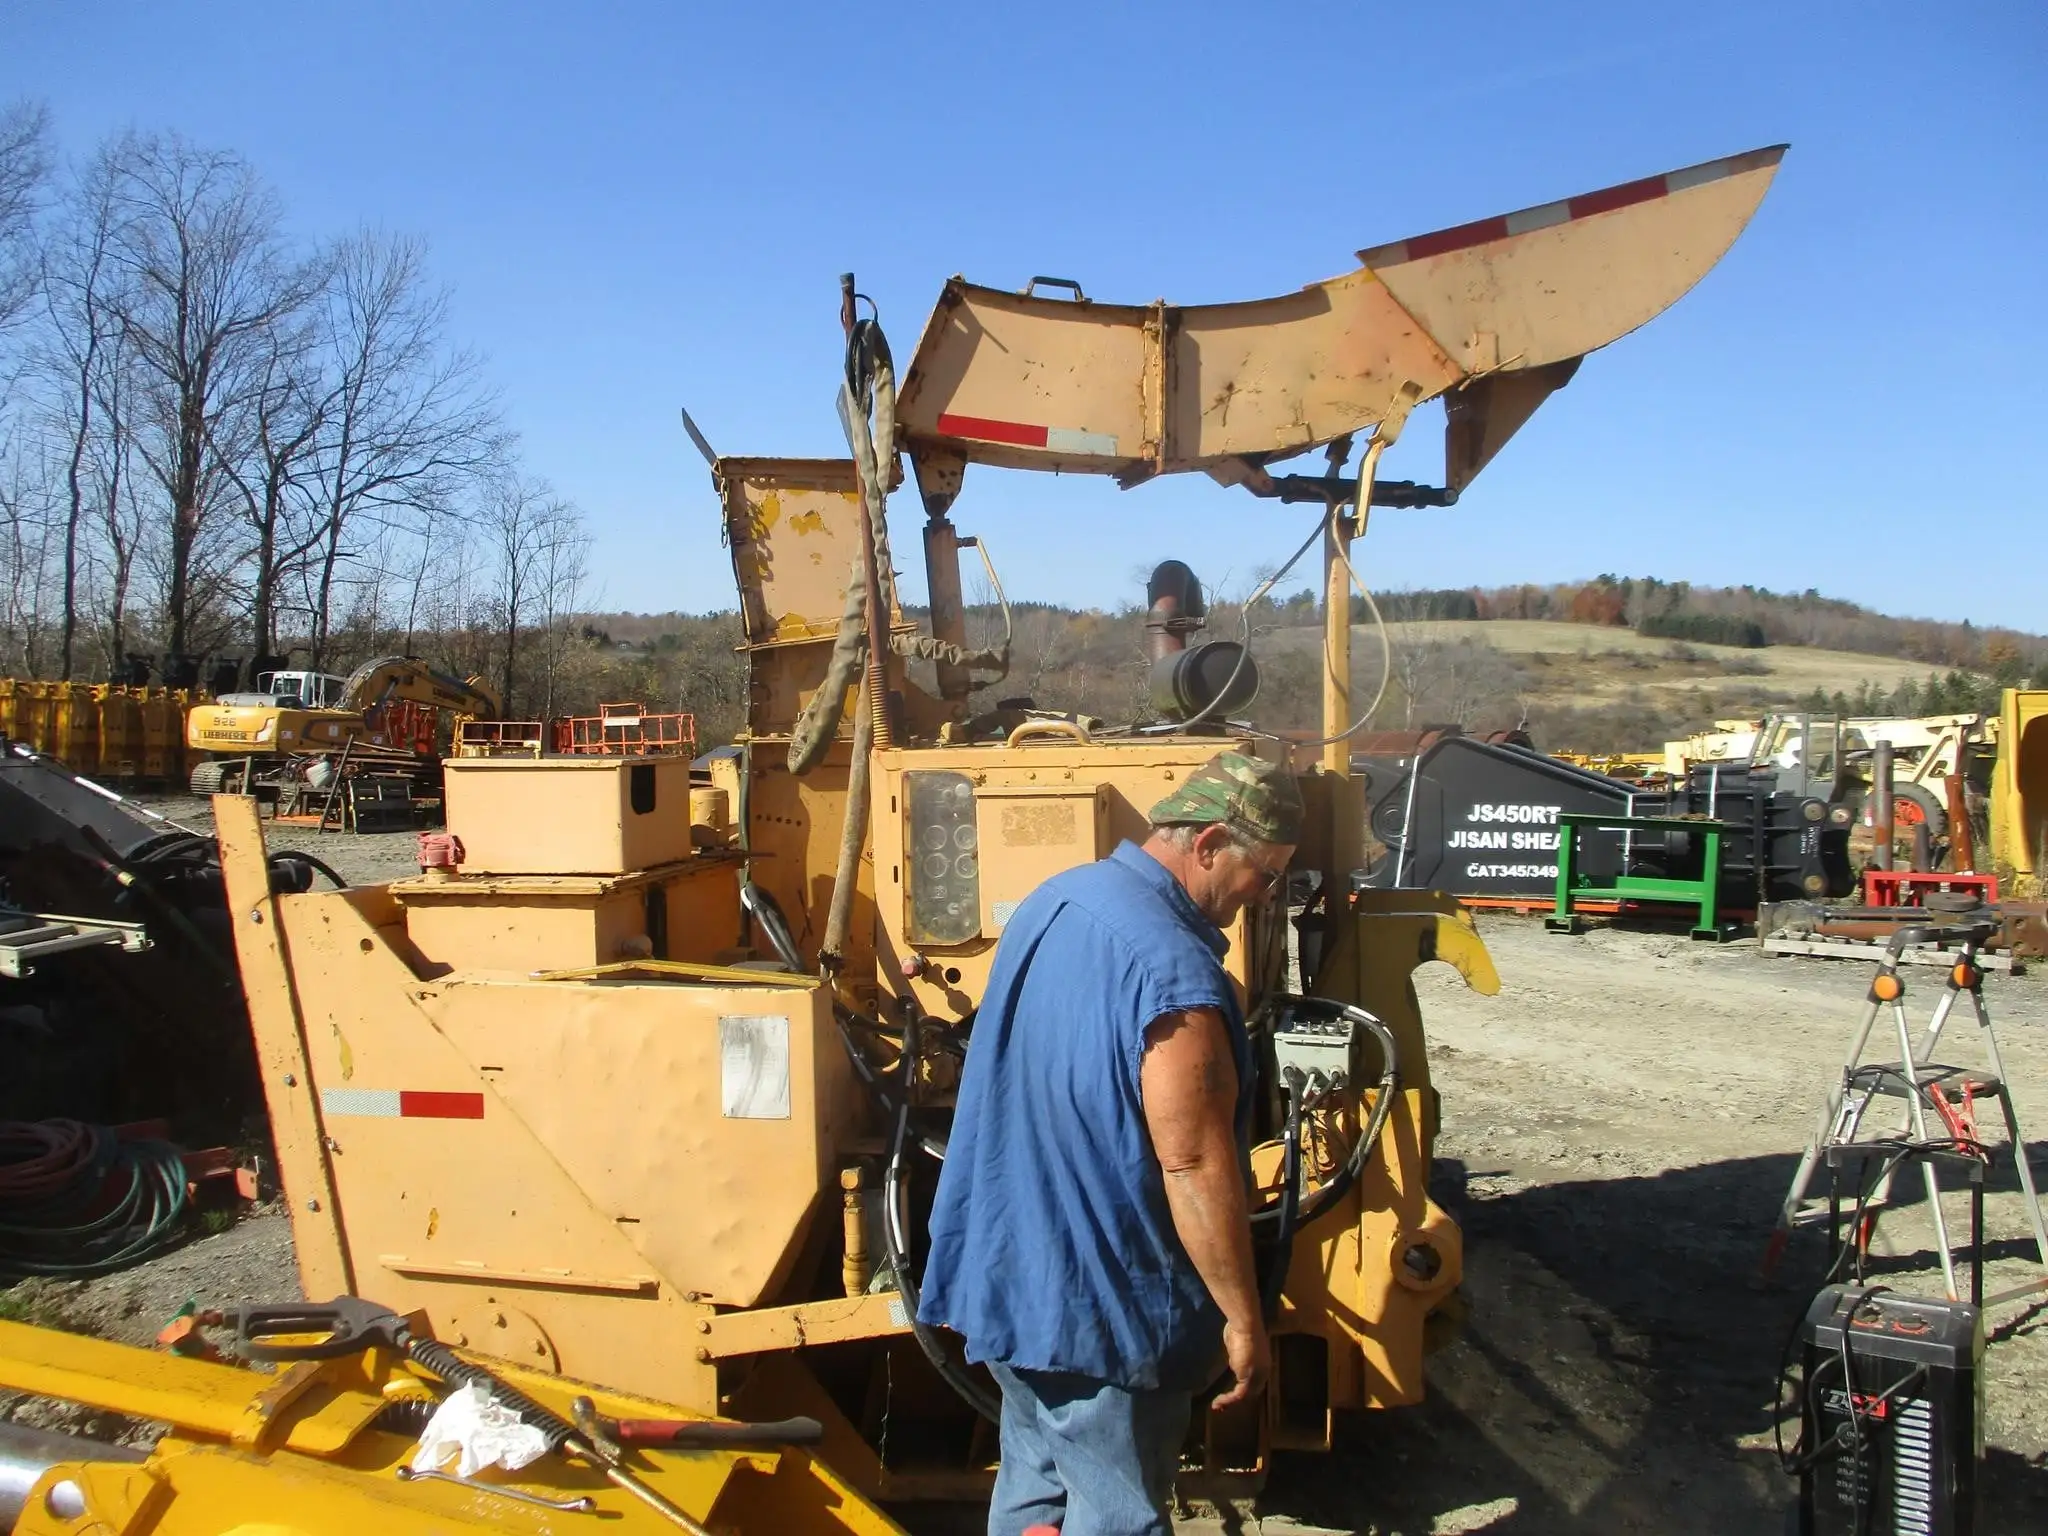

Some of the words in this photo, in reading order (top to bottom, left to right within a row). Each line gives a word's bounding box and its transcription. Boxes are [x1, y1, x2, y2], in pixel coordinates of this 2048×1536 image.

[213, 716, 237, 727] 926
[203, 730, 247, 741] LIEBHERR
[1467, 804, 1561, 824] JS450RT
[1448, 830, 1508, 849] JISAN
[1511, 831, 1581, 852] SHE
